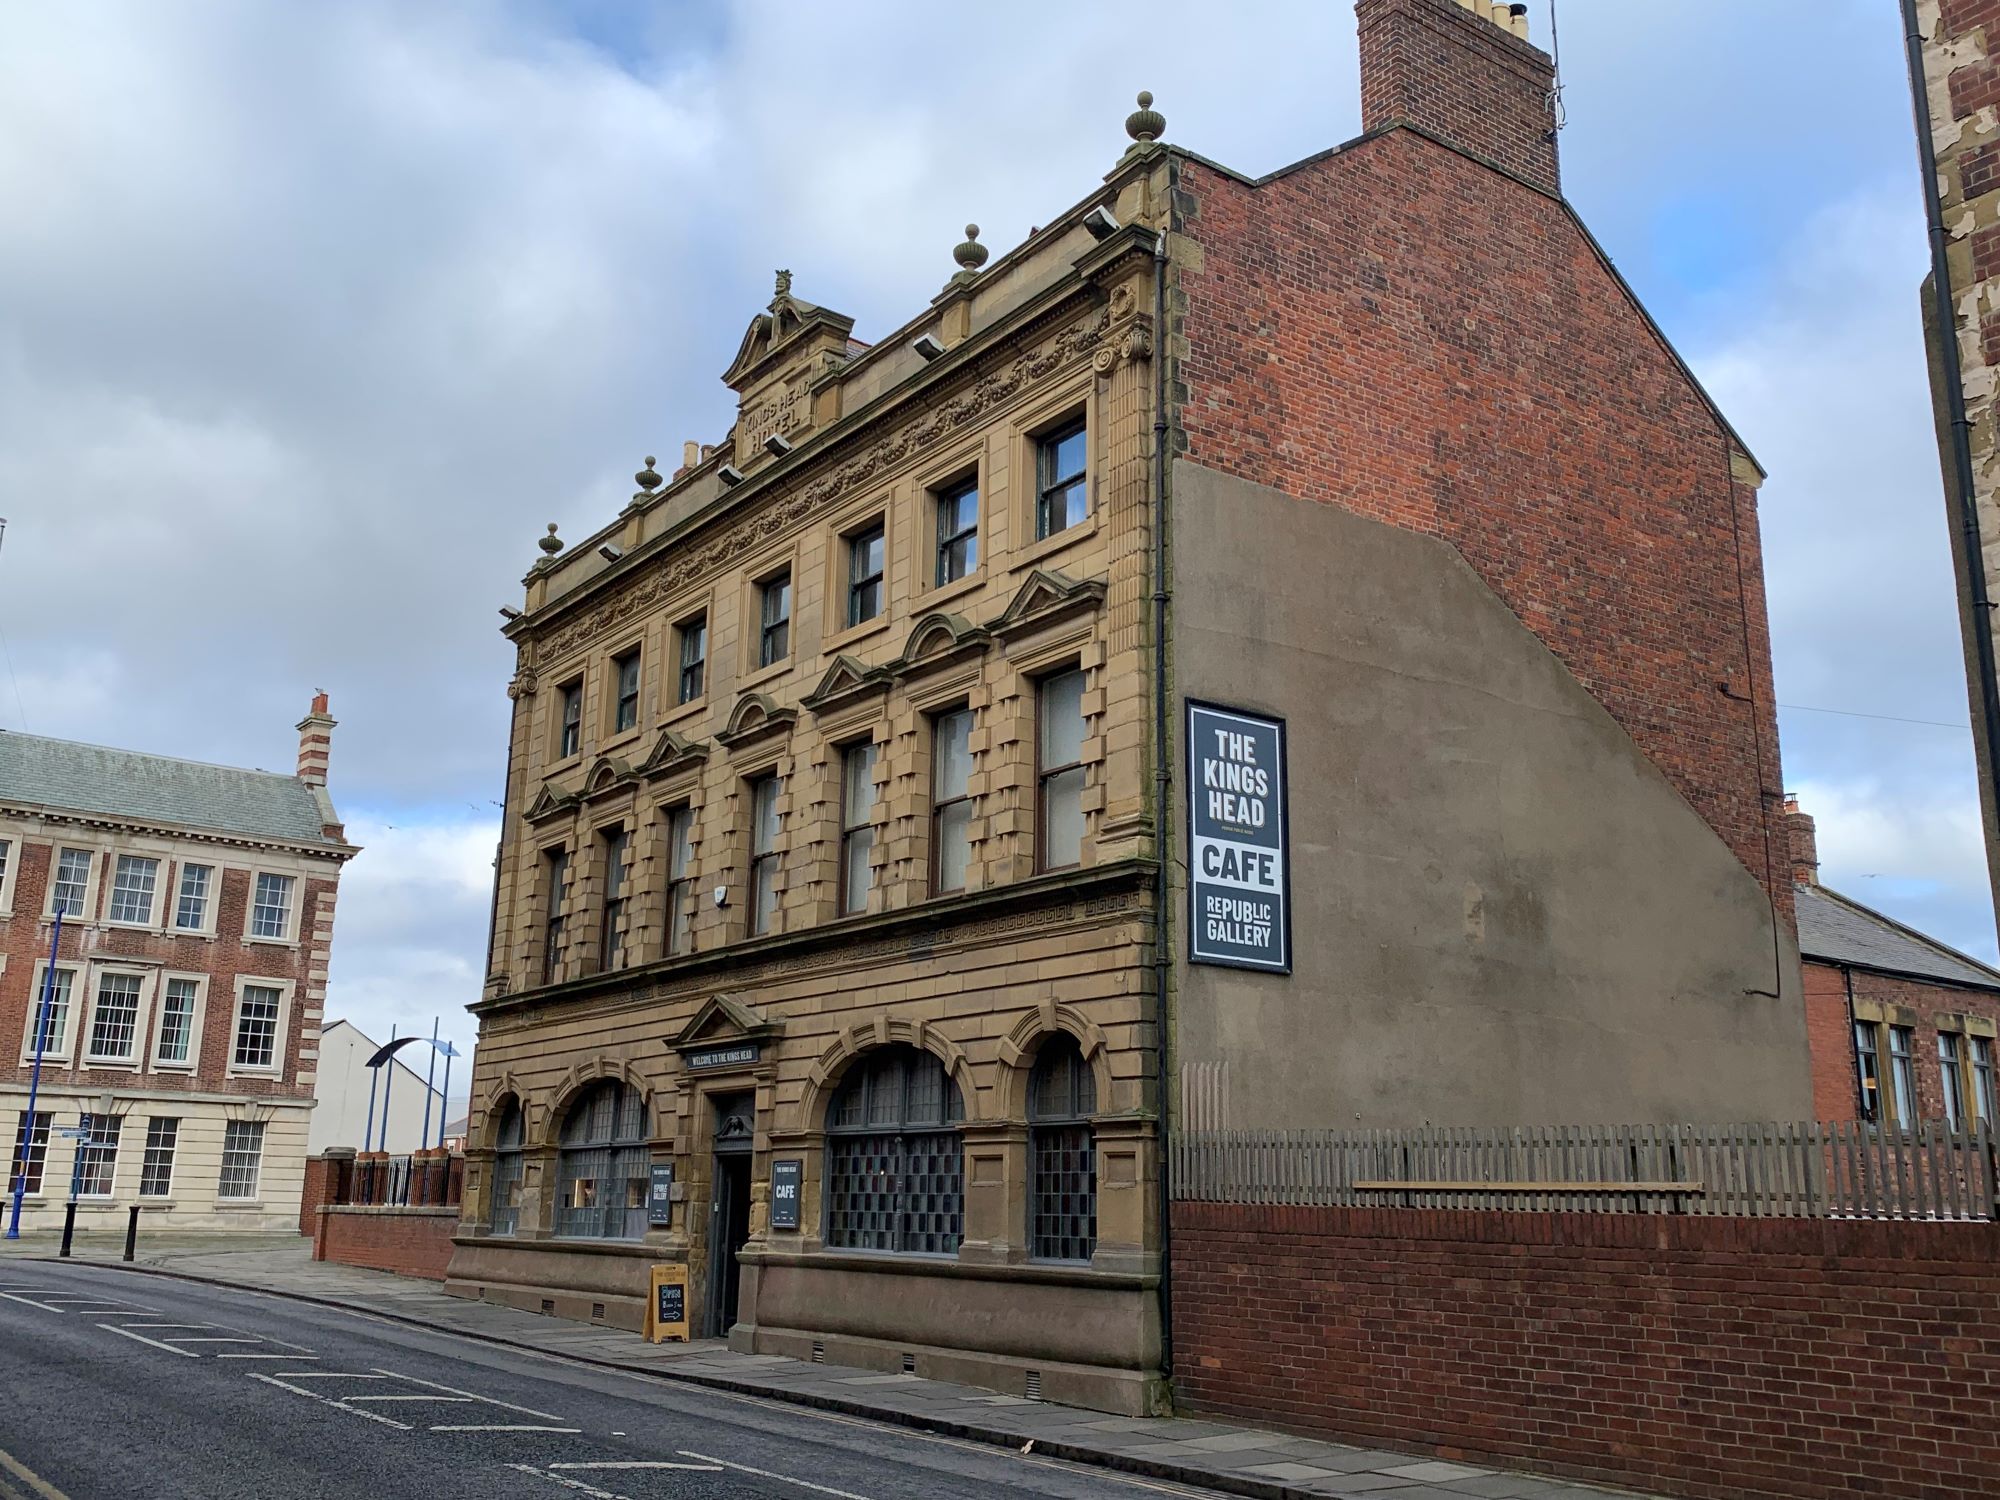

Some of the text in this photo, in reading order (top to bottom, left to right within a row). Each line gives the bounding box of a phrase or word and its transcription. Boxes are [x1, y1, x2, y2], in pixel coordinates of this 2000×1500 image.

[745, 380, 811, 435] KINGS HEAD
[1214, 729, 1256, 764] THE
[1204, 758, 1268, 797] KINGS
[1209, 790, 1265, 827] HEAD
[1203, 844, 1274, 886] CAFE
[1207, 895, 1271, 923] REPUBLIC
[1207, 919, 1271, 947] GALLERY
[692, 1055, 711, 1066] WELCOME
[712, 1054, 718, 1063] TO
[718, 1052, 727, 1063] THE
[741, 1049, 752, 1060] HEAD
[776, 1185, 794, 1199] CAFE
